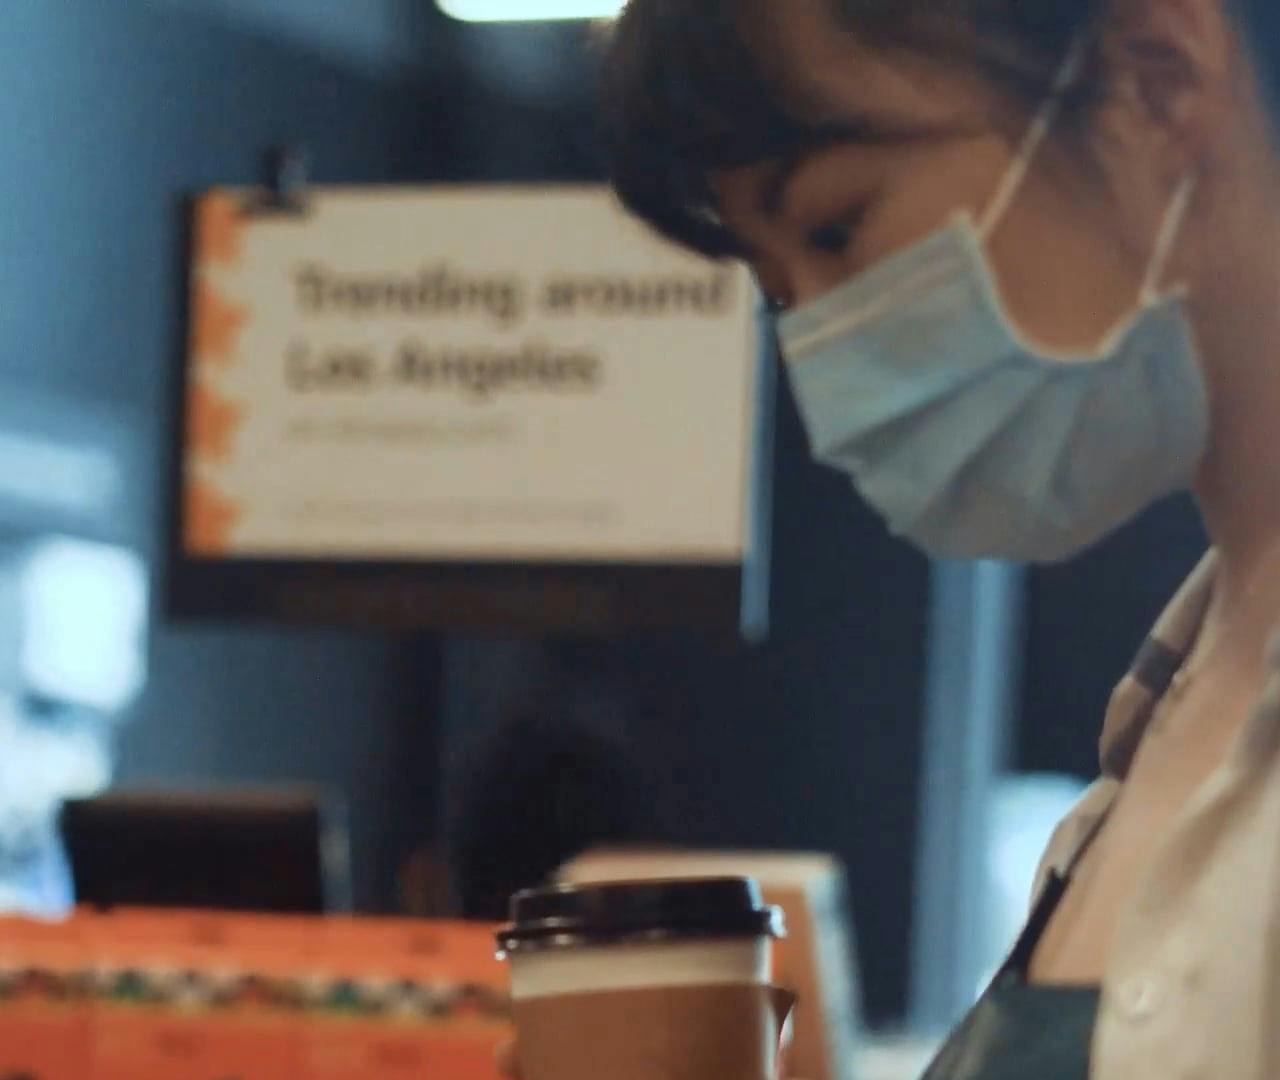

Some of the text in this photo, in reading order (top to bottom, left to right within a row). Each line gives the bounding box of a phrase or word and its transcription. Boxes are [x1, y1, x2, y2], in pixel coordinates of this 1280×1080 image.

[292, 260, 733, 329] Trending around
[284, 337, 602, 402] Los Angeles
